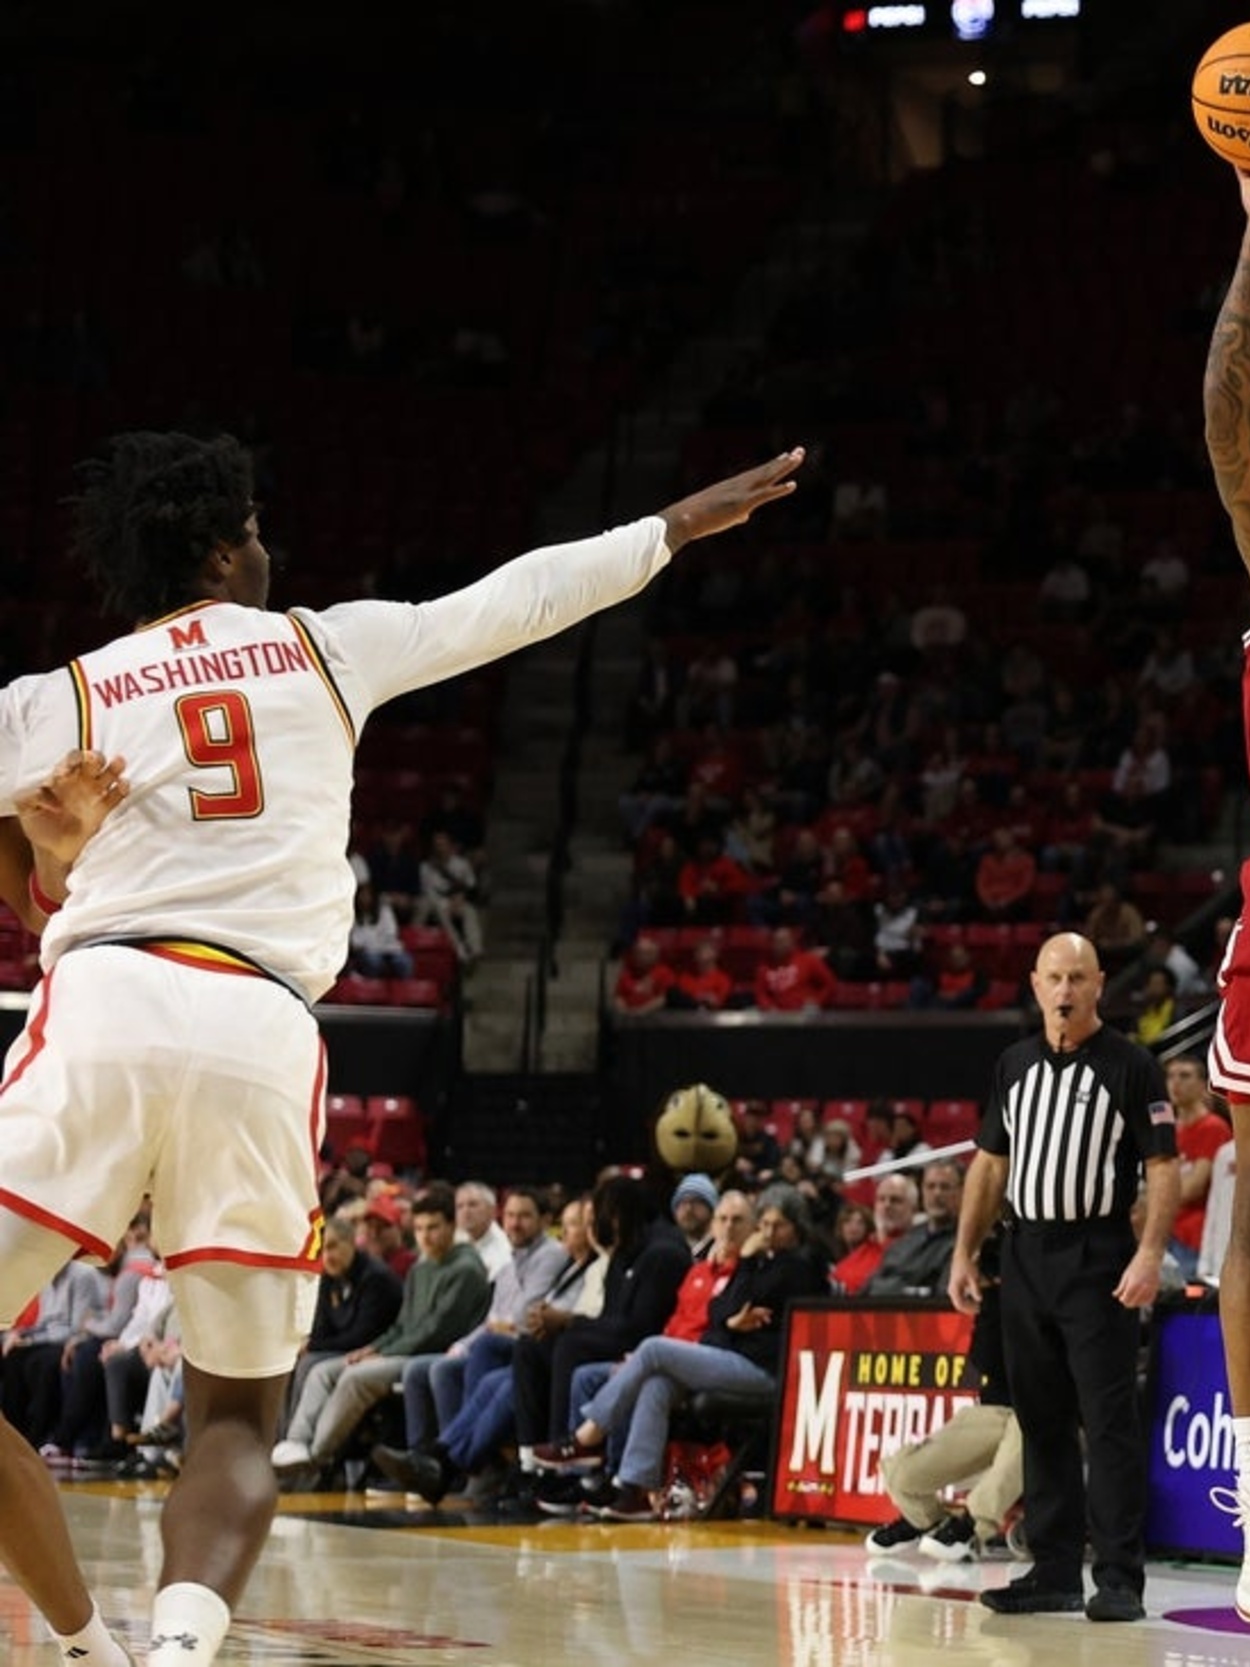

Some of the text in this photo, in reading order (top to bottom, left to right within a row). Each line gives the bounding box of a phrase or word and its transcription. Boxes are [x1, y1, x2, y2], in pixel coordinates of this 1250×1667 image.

[168, 620, 208, 650] M
[93, 641, 309, 709] WASHINGTON
[174, 689, 265, 822] 9
[856, 1353, 966, 1387] HOME OF
[789, 1350, 845, 1475] M
